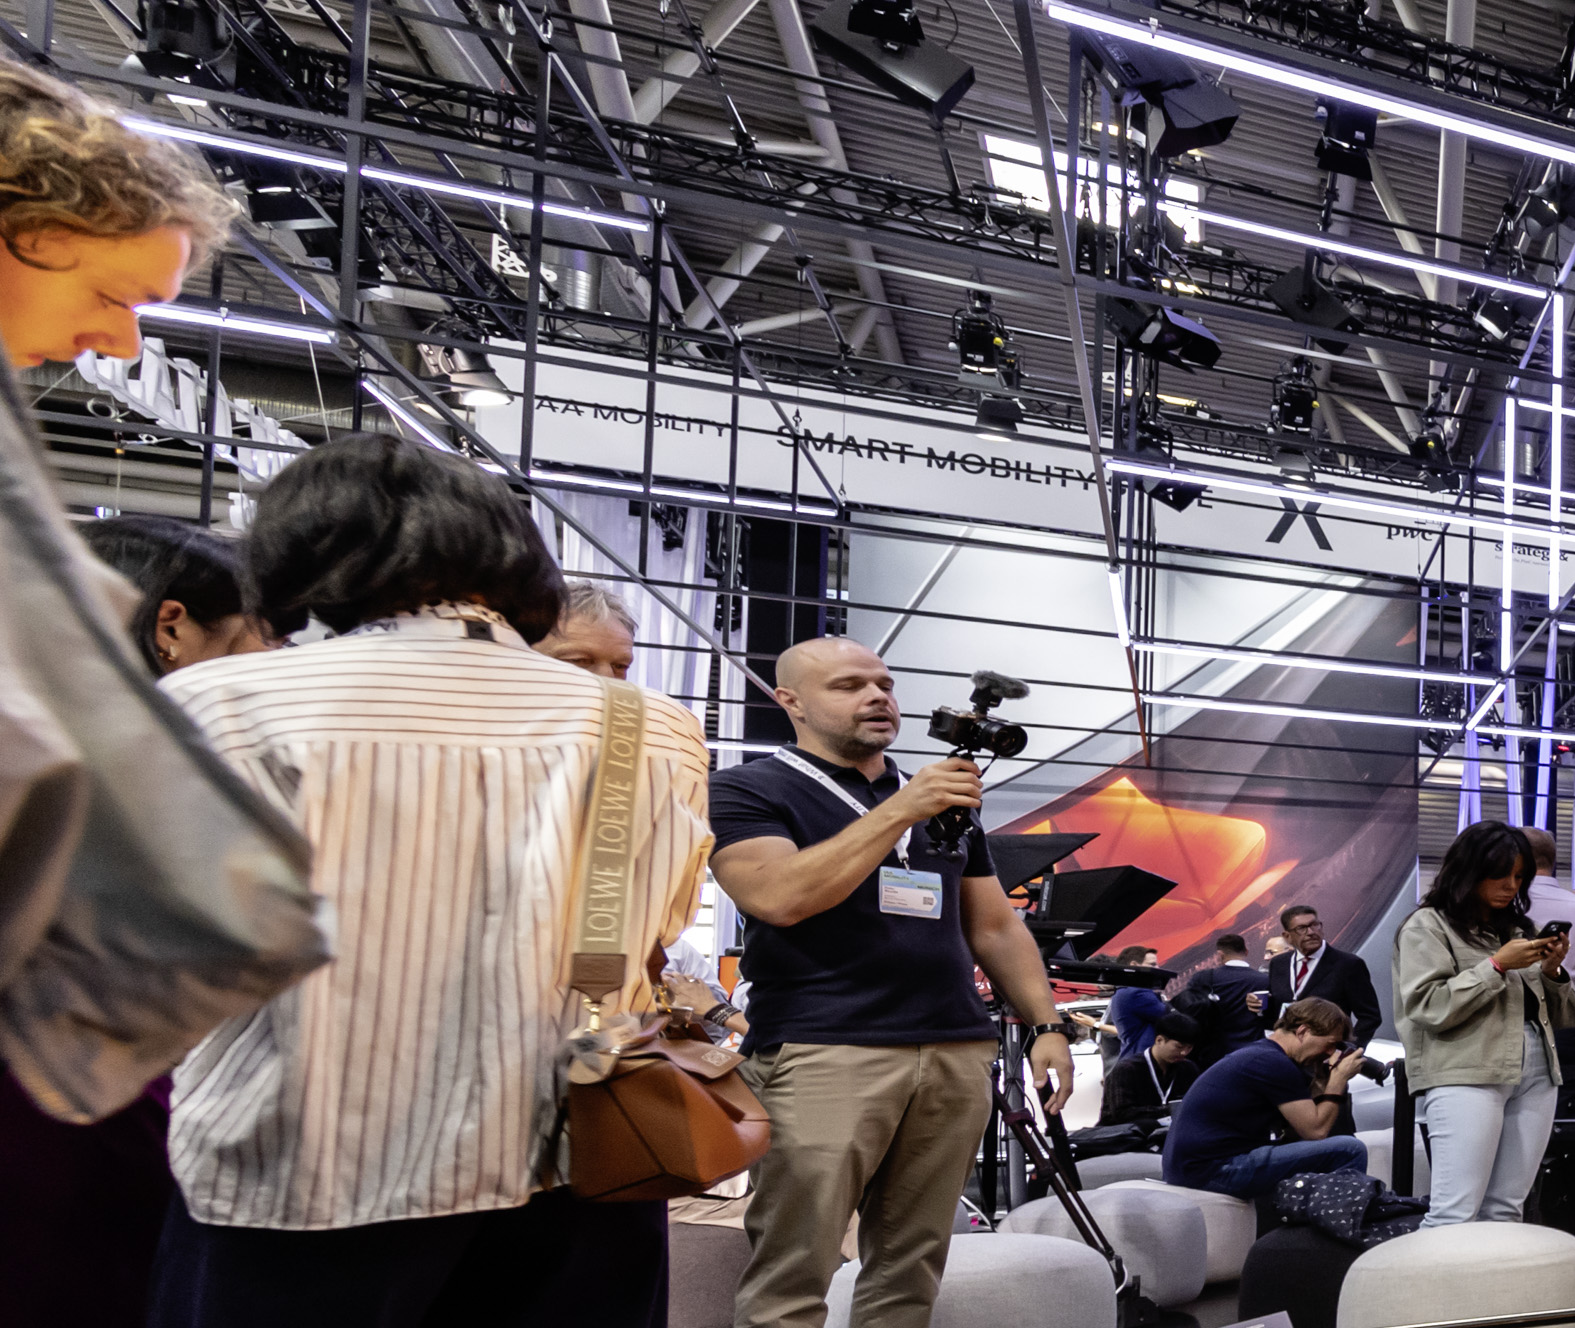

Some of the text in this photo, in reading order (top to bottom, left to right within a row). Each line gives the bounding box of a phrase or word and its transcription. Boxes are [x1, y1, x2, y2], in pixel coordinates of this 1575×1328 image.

[534, 396, 584, 417] AA
[776, 424, 1096, 491] SMART MOBILITY
[607, 696, 641, 771] LOEWE
[595, 775, 633, 855] LOEWE
[585, 862, 625, 943] LOEWE
